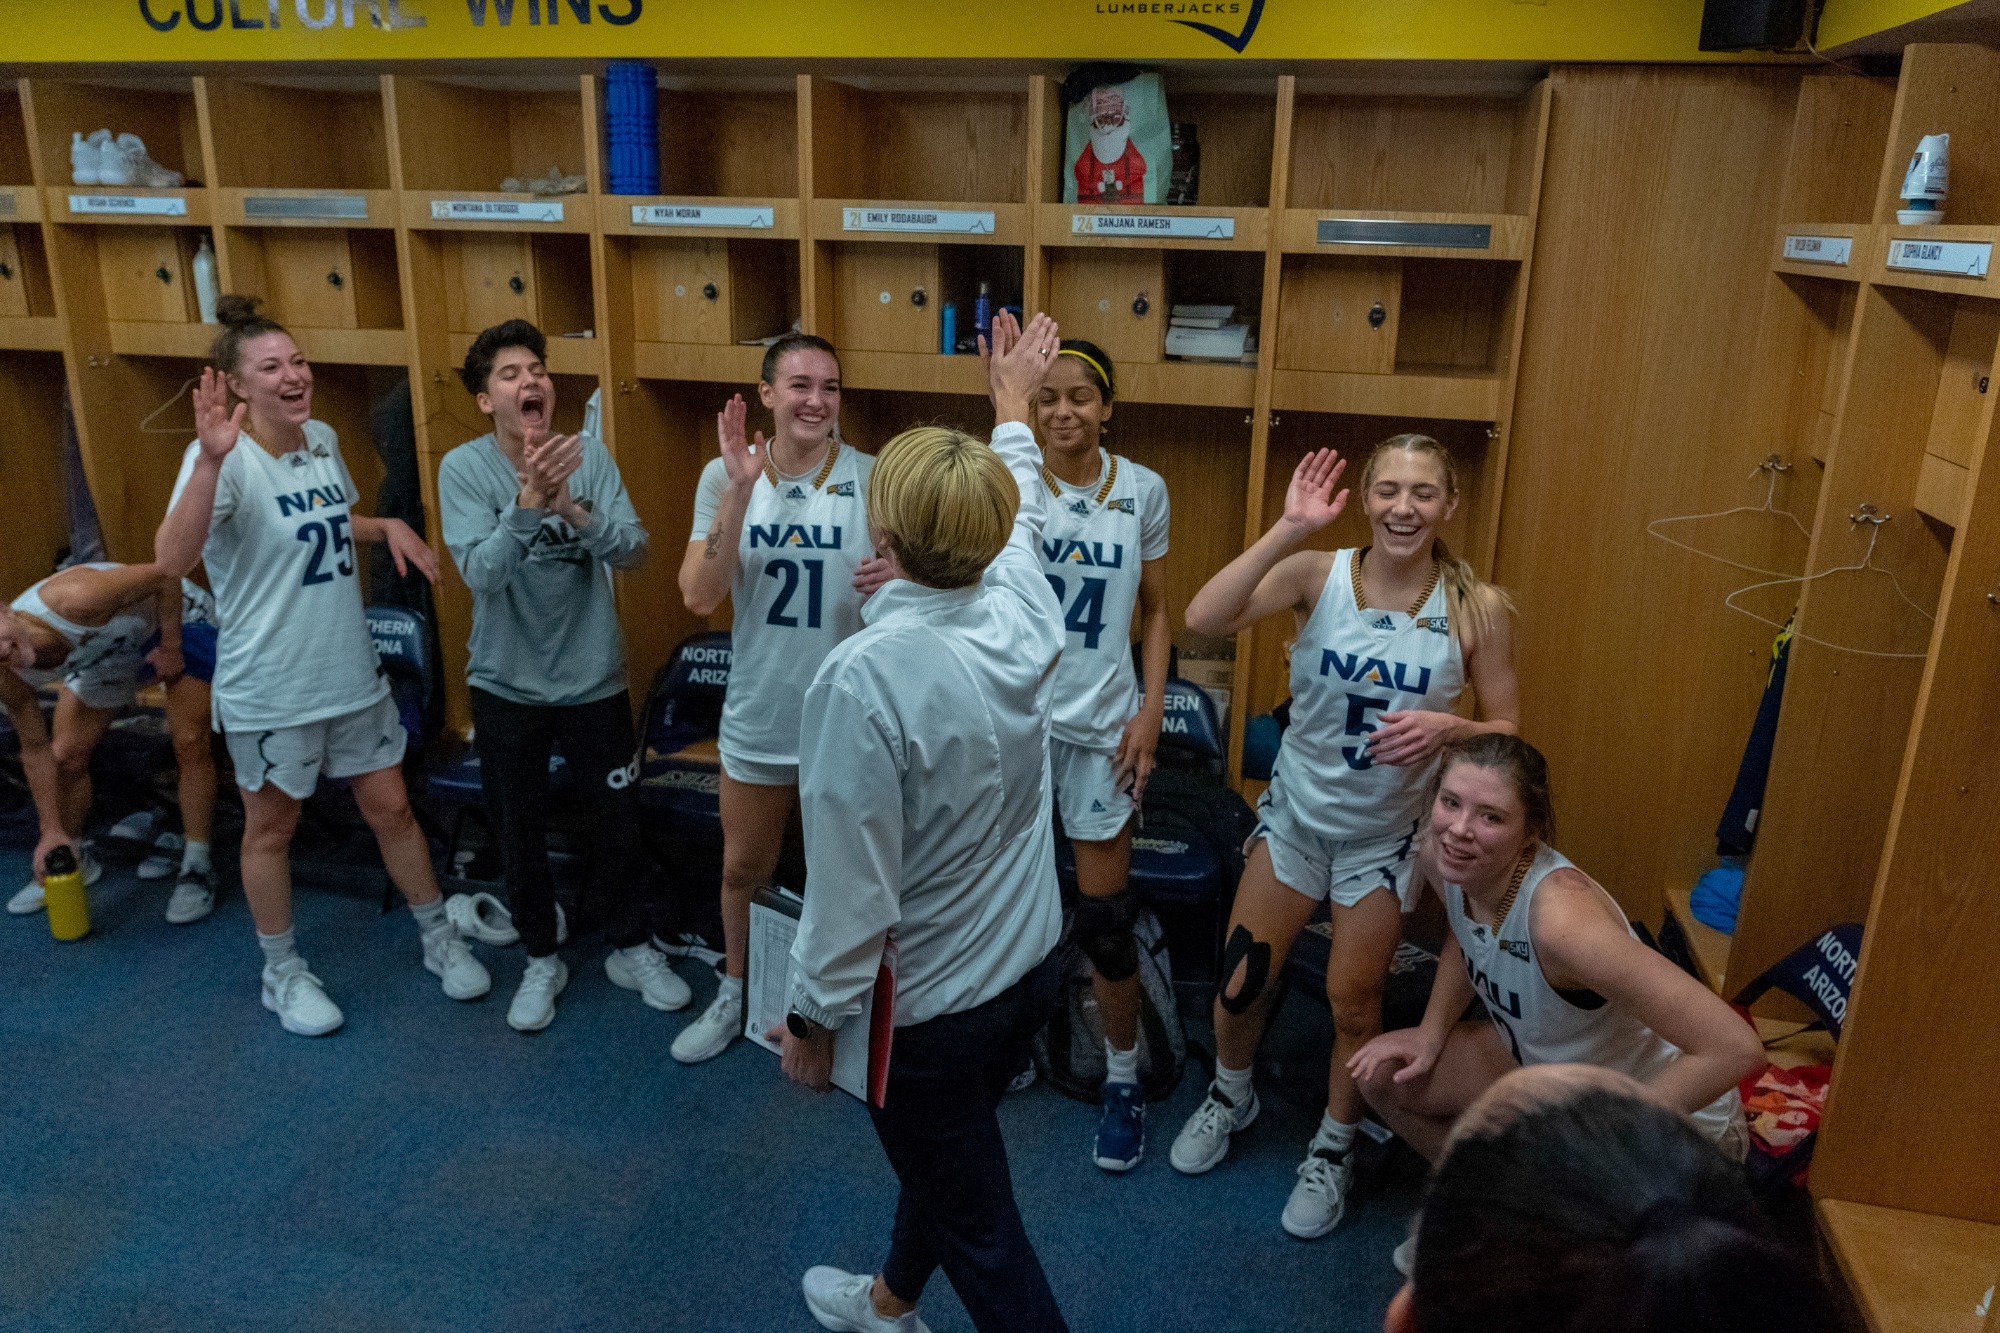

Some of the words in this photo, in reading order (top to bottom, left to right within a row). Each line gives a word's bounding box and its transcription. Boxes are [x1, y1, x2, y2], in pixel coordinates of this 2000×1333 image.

[1096, 3, 1241, 14] LUMBERJACKS
[654, 208, 674, 217] NYAH
[675, 209, 701, 218] MORAN
[867, 212, 889, 223] EMILY
[891, 213, 938, 224] RODABAUGH
[1077, 216, 1093, 232] 24
[1098, 217, 1135, 229] SANJANA
[1137, 218, 1171, 229] RAMESH
[275, 484, 347, 518] NAU
[296, 514, 354, 587] 25
[749, 523, 842, 550] NAU
[764, 558, 824, 629] 21
[688, 667, 728, 686] ARIZ
[1320, 648, 1432, 696] NAU
[1342, 692, 1391, 771] 5
[1816, 930, 1857, 987] NORT
